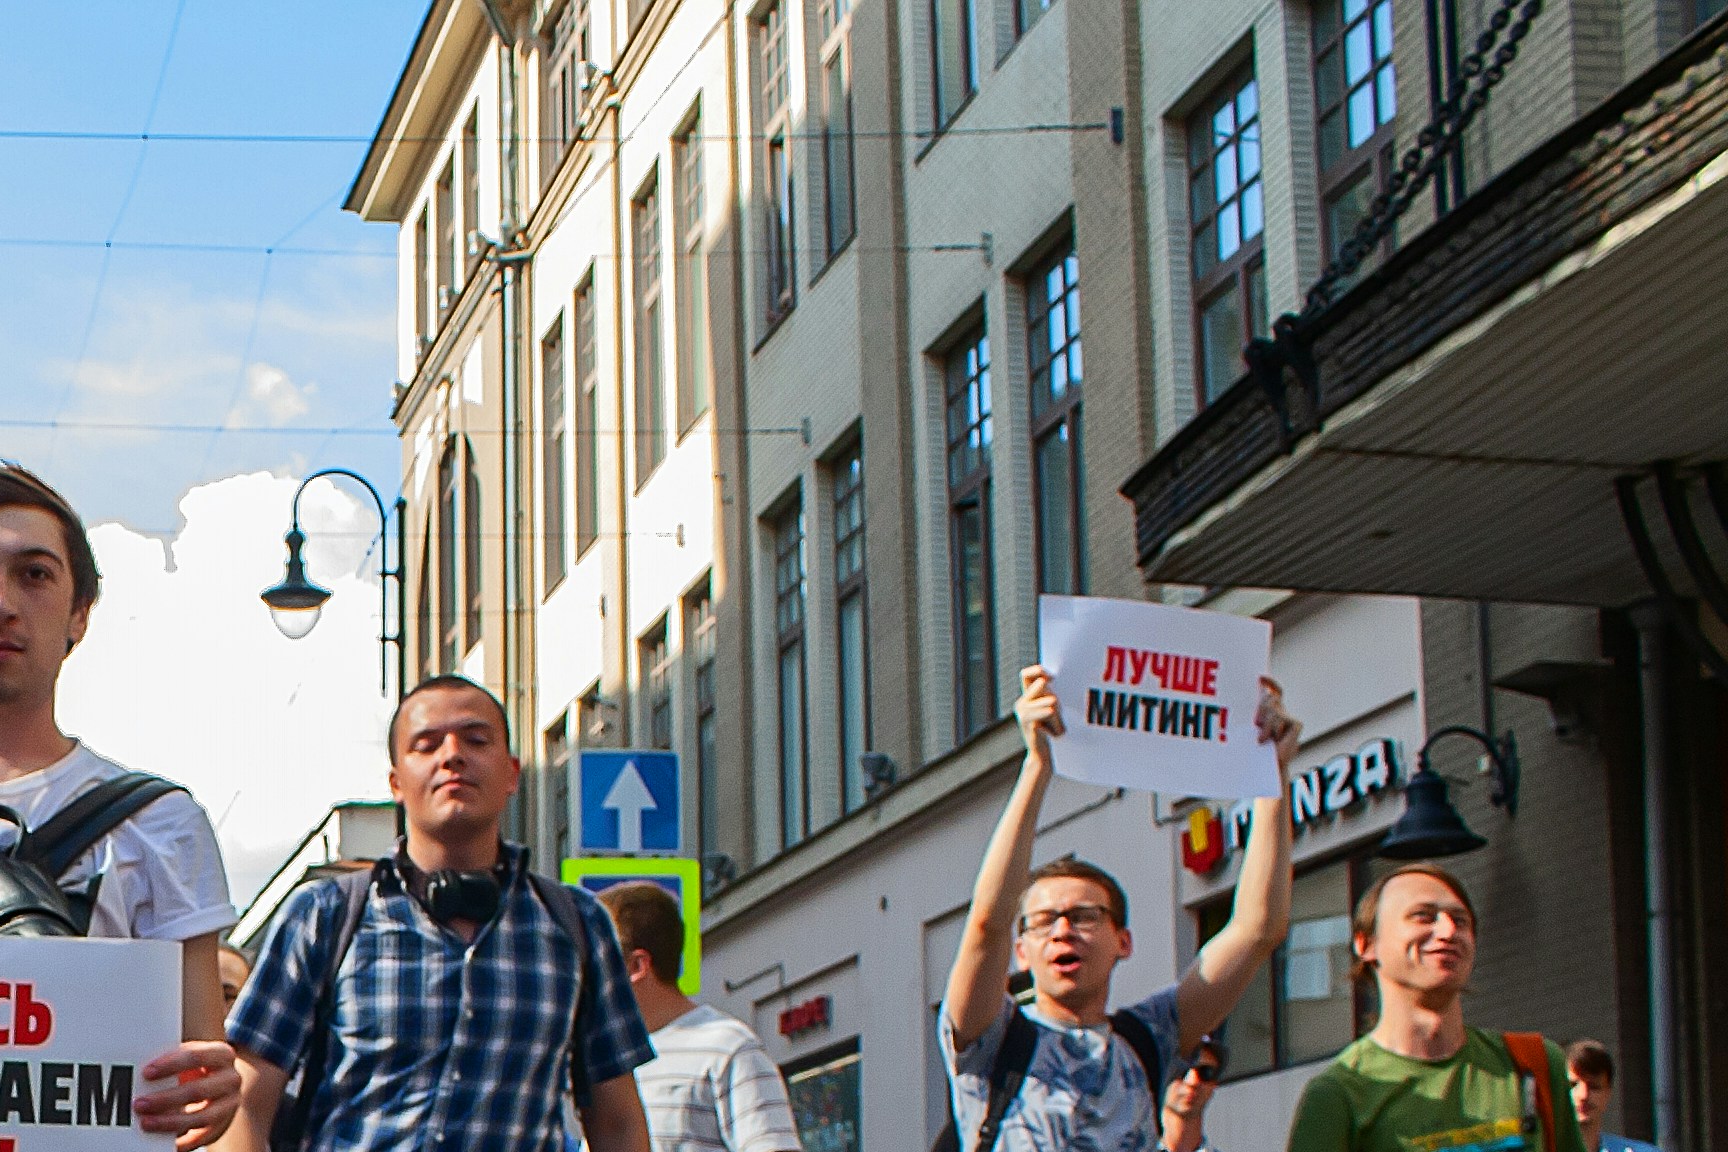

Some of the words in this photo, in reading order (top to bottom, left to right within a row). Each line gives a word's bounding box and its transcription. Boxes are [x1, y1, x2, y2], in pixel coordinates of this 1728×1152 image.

[1102, 646, 1220, 697] ЛУЧШЕ
[1086, 687, 1229, 743] МИТИНГ!
[1229, 738, 1389, 849] MNZA
